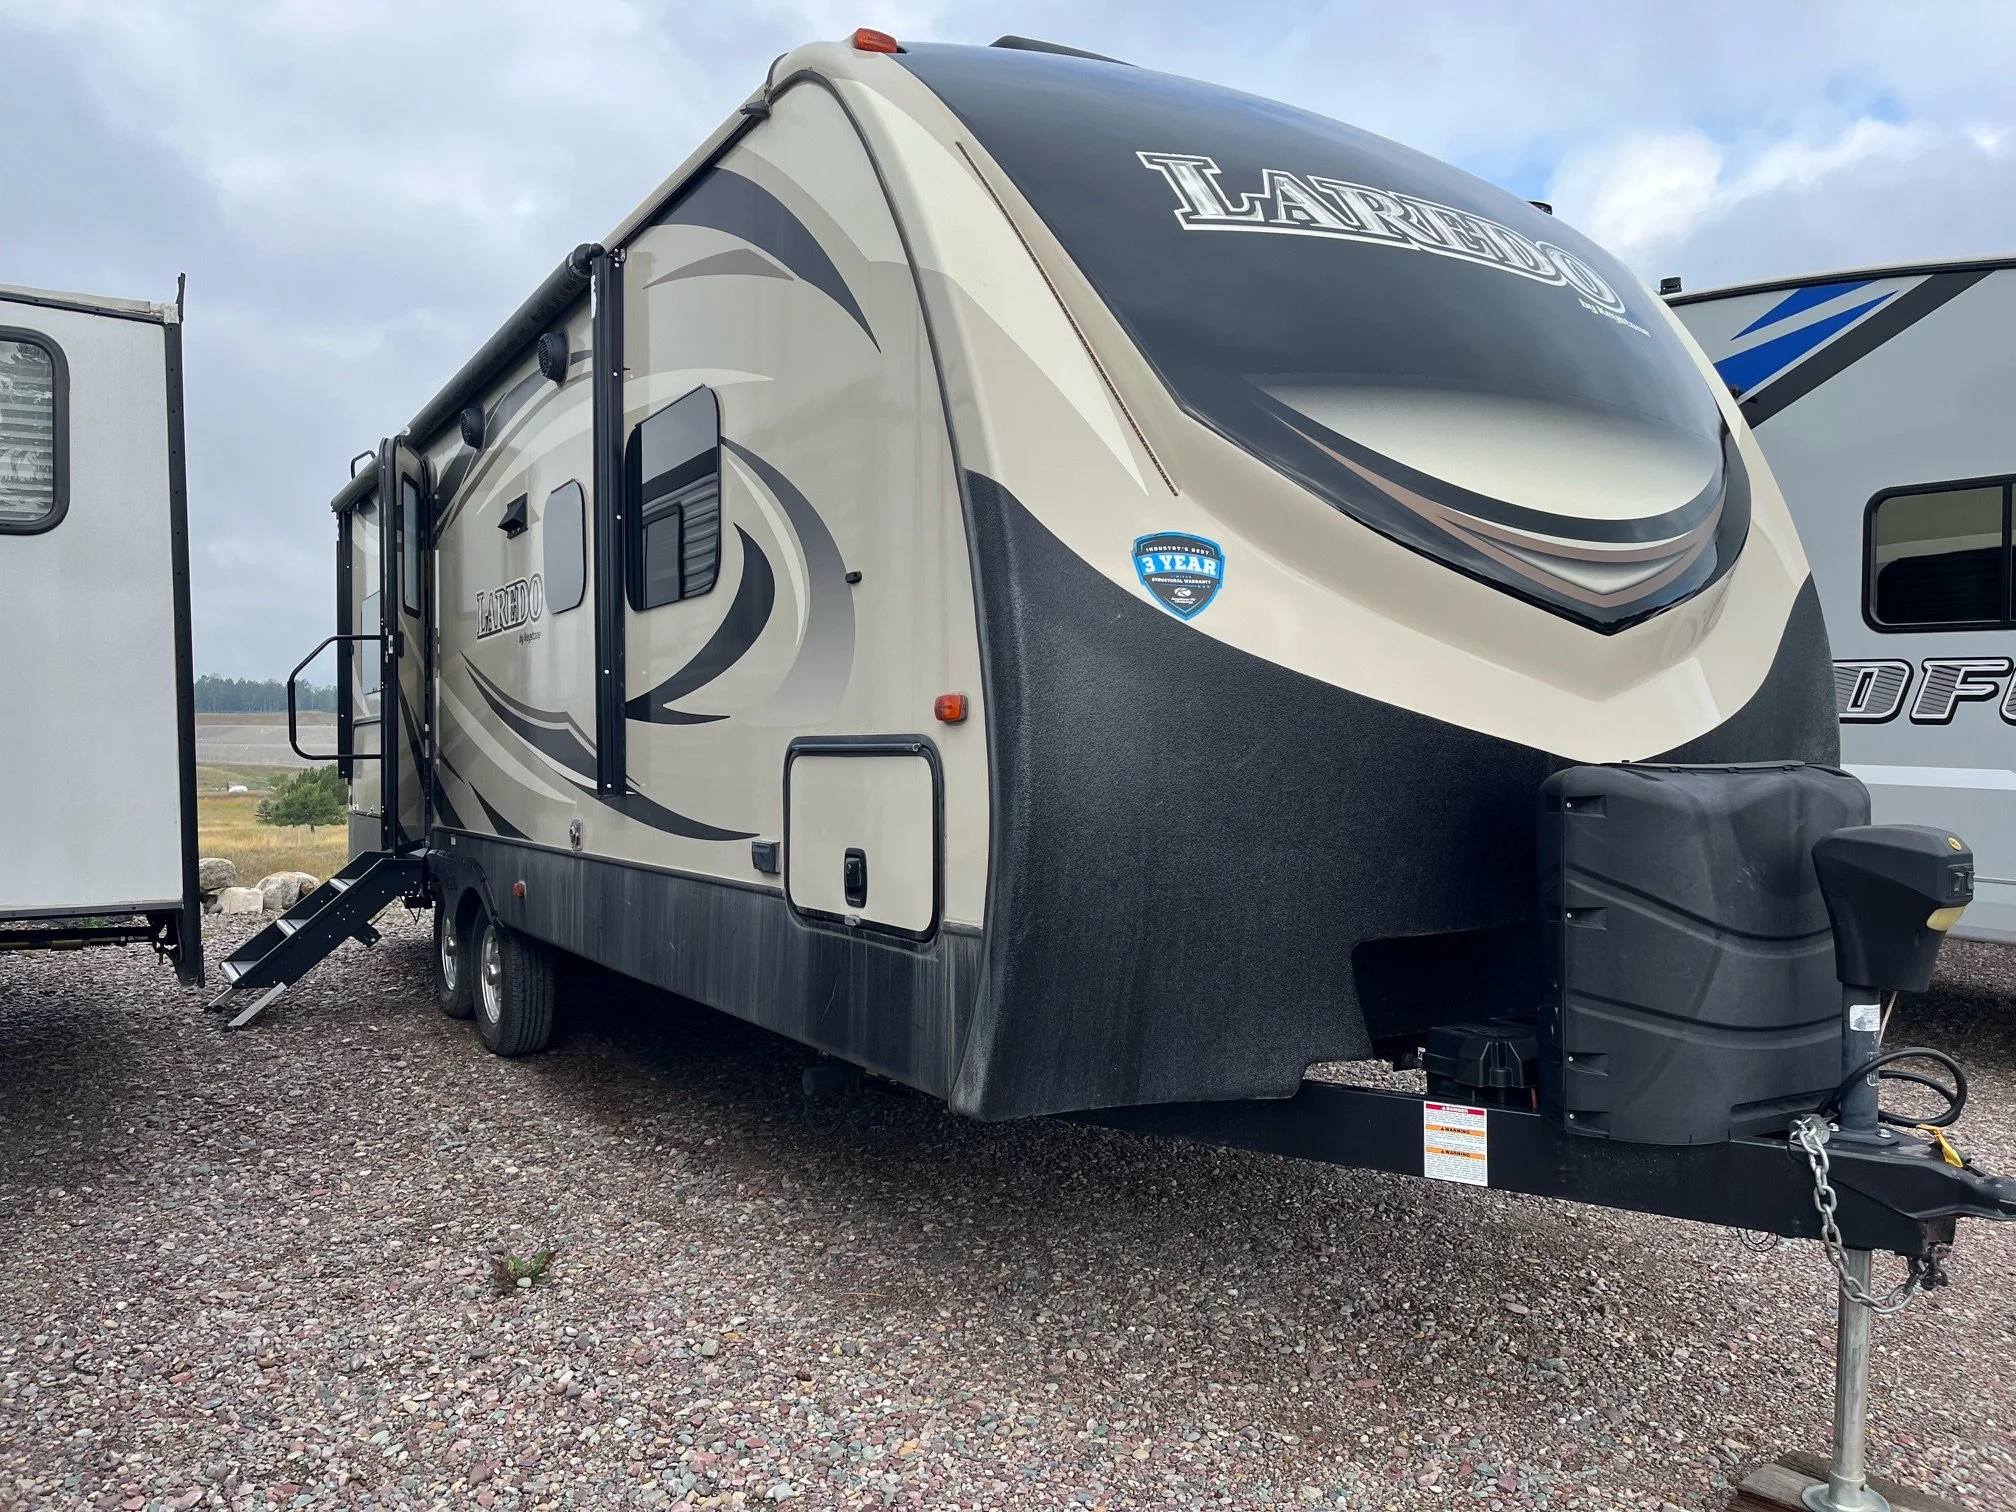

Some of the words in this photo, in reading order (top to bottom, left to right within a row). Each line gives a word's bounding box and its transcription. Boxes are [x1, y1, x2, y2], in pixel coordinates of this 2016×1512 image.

[1136, 151, 1626, 313] LAREDO
[1579, 298, 1598, 314] by
[1191, 547, 1210, 555] BEST
[1142, 557, 1155, 573] 3
[1159, 555, 1217, 575] YEAR
[476, 572, 543, 642] LAREDO
[1833, 657, 2016, 726] DF
[1445, 1126, 1470, 1135] WARNING
[1445, 1149, 1470, 1158] WARNING
